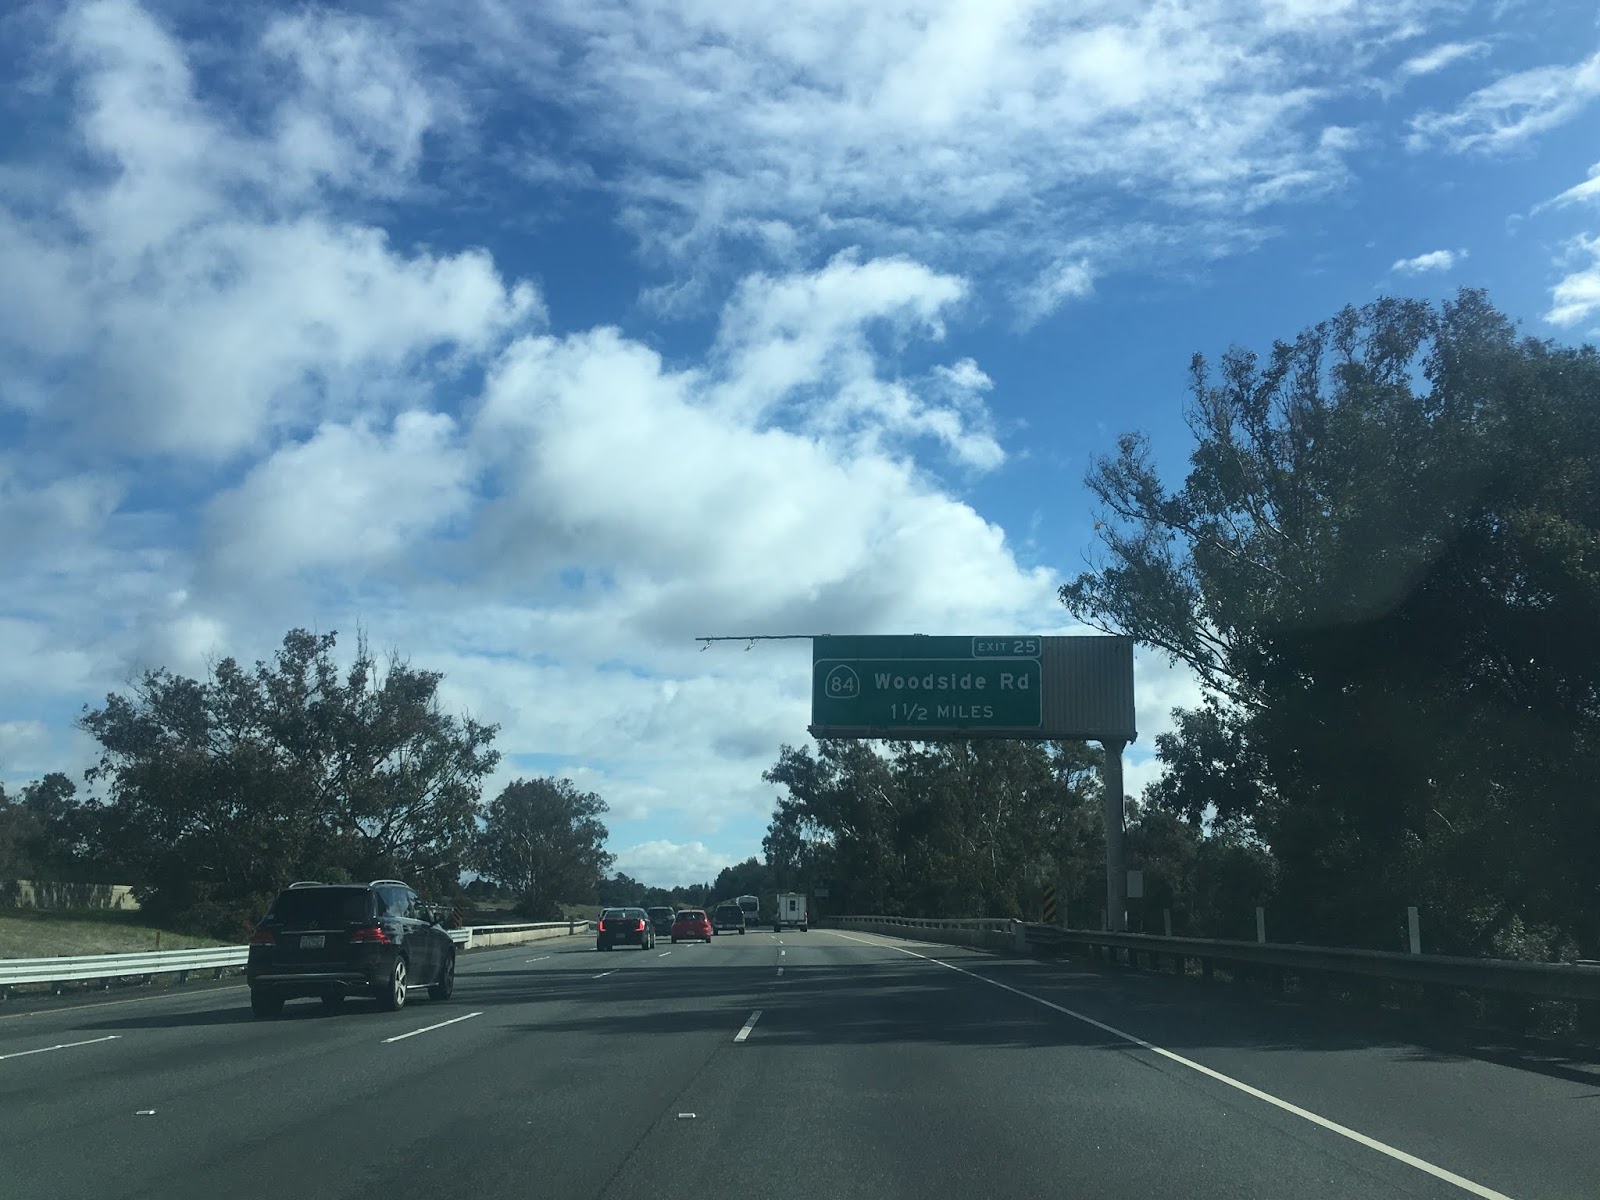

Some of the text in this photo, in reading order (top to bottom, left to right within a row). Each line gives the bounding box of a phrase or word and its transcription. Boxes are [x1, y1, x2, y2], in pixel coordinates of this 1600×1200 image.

[978, 640, 1036, 653] EXIT 25
[831, 676, 854, 692] 84
[874, 673, 1029, 690] Woodside Rd
[937, 705, 994, 718] MILES
